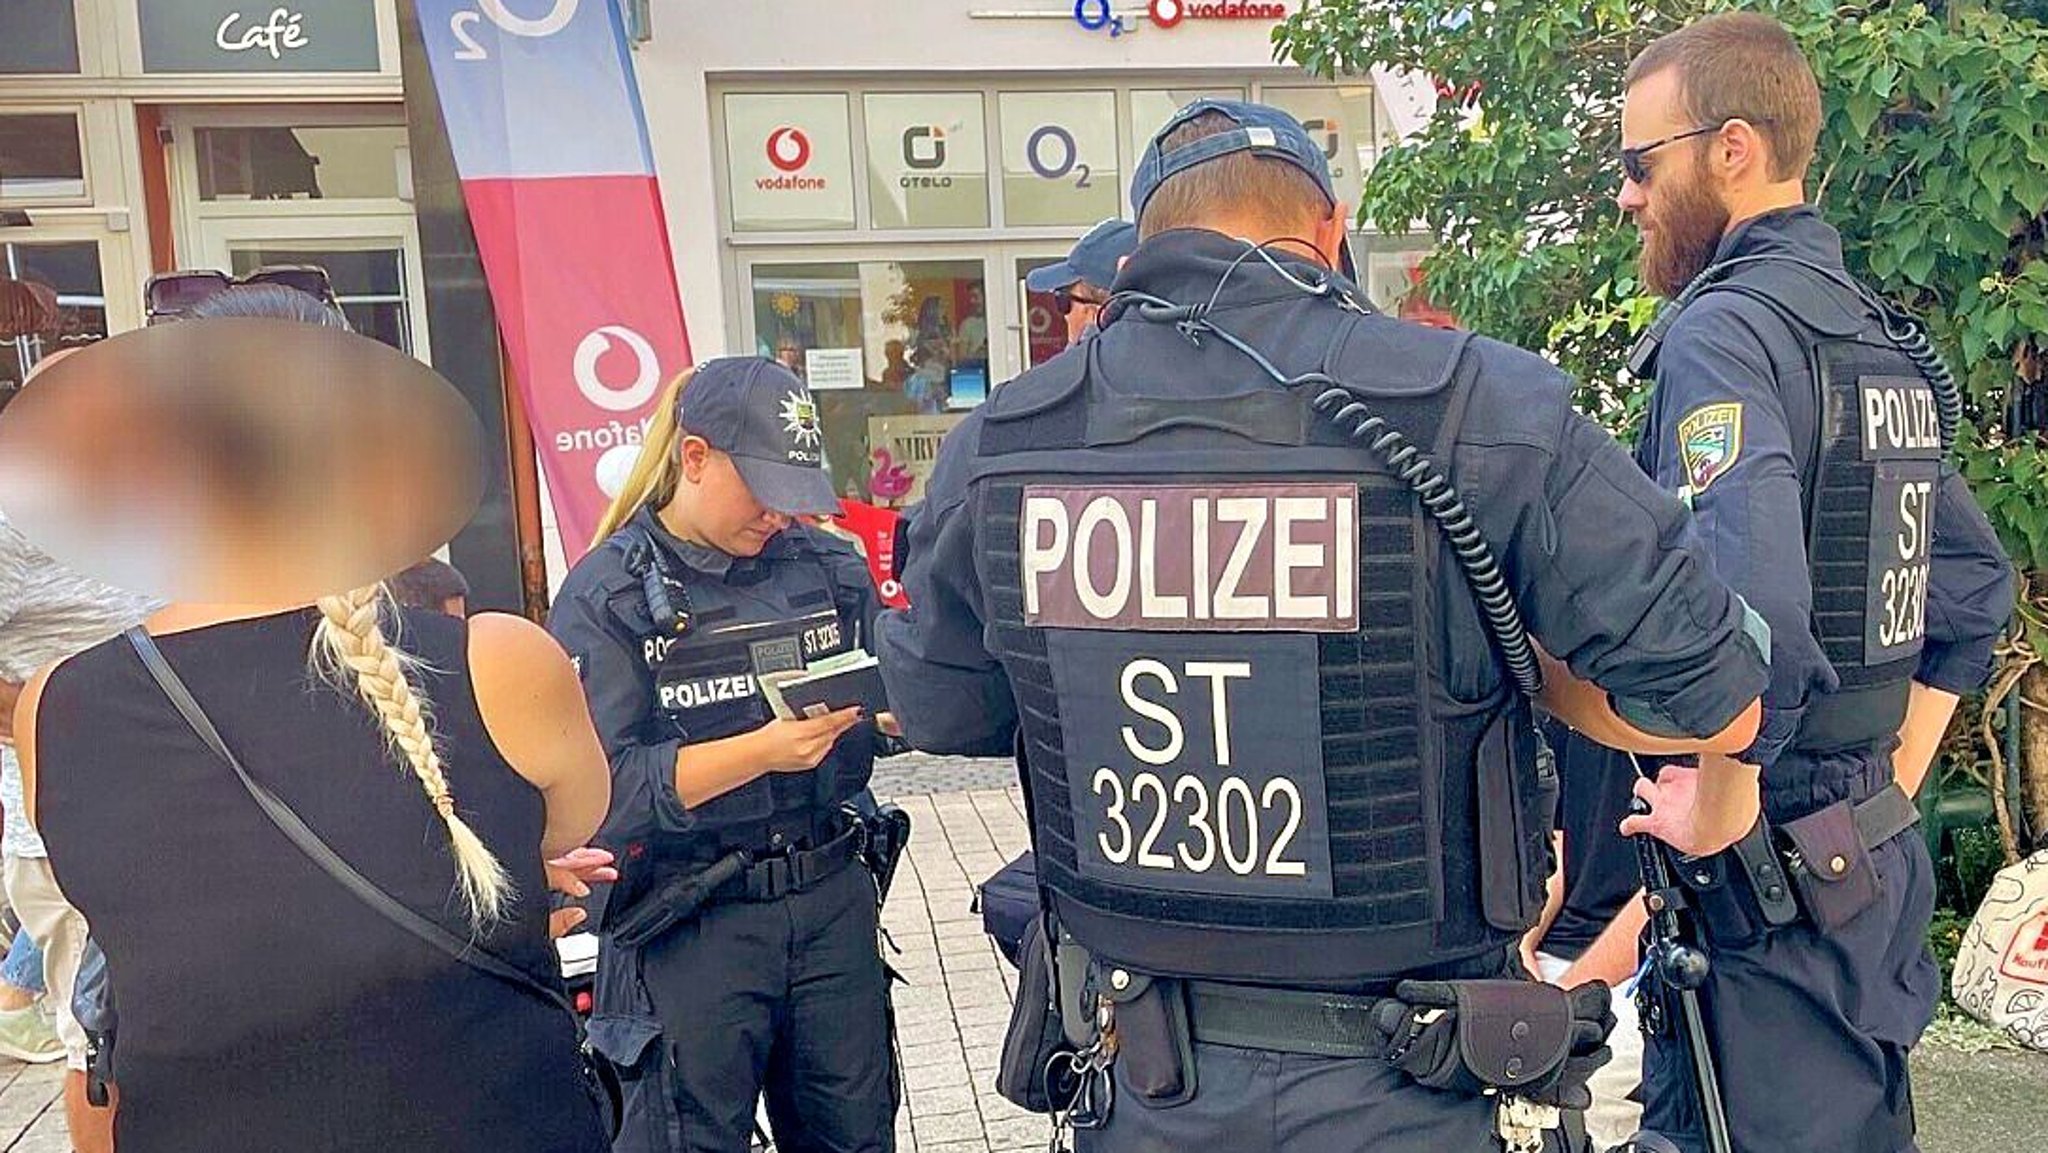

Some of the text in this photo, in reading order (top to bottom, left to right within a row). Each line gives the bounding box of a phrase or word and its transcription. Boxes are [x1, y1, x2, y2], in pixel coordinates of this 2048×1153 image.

[217, 8, 309, 59] Café
[1188, 0, 1285, 18] vodafone
[756, 176, 826, 190] vodafone
[1681, 408, 1735, 441] POLIZEI
[1864, 388, 1940, 450] POLIZE
[894, 435, 941, 461] NIRV
[1898, 482, 1931, 561] ST
[1023, 496, 1353, 619] POLIZEI
[1880, 564, 1930, 647] 3230
[804, 629, 818, 654] ST
[660, 674, 755, 708] POLIZEI
[1119, 658, 1251, 766] ST
[1093, 768, 1306, 875] 32302
